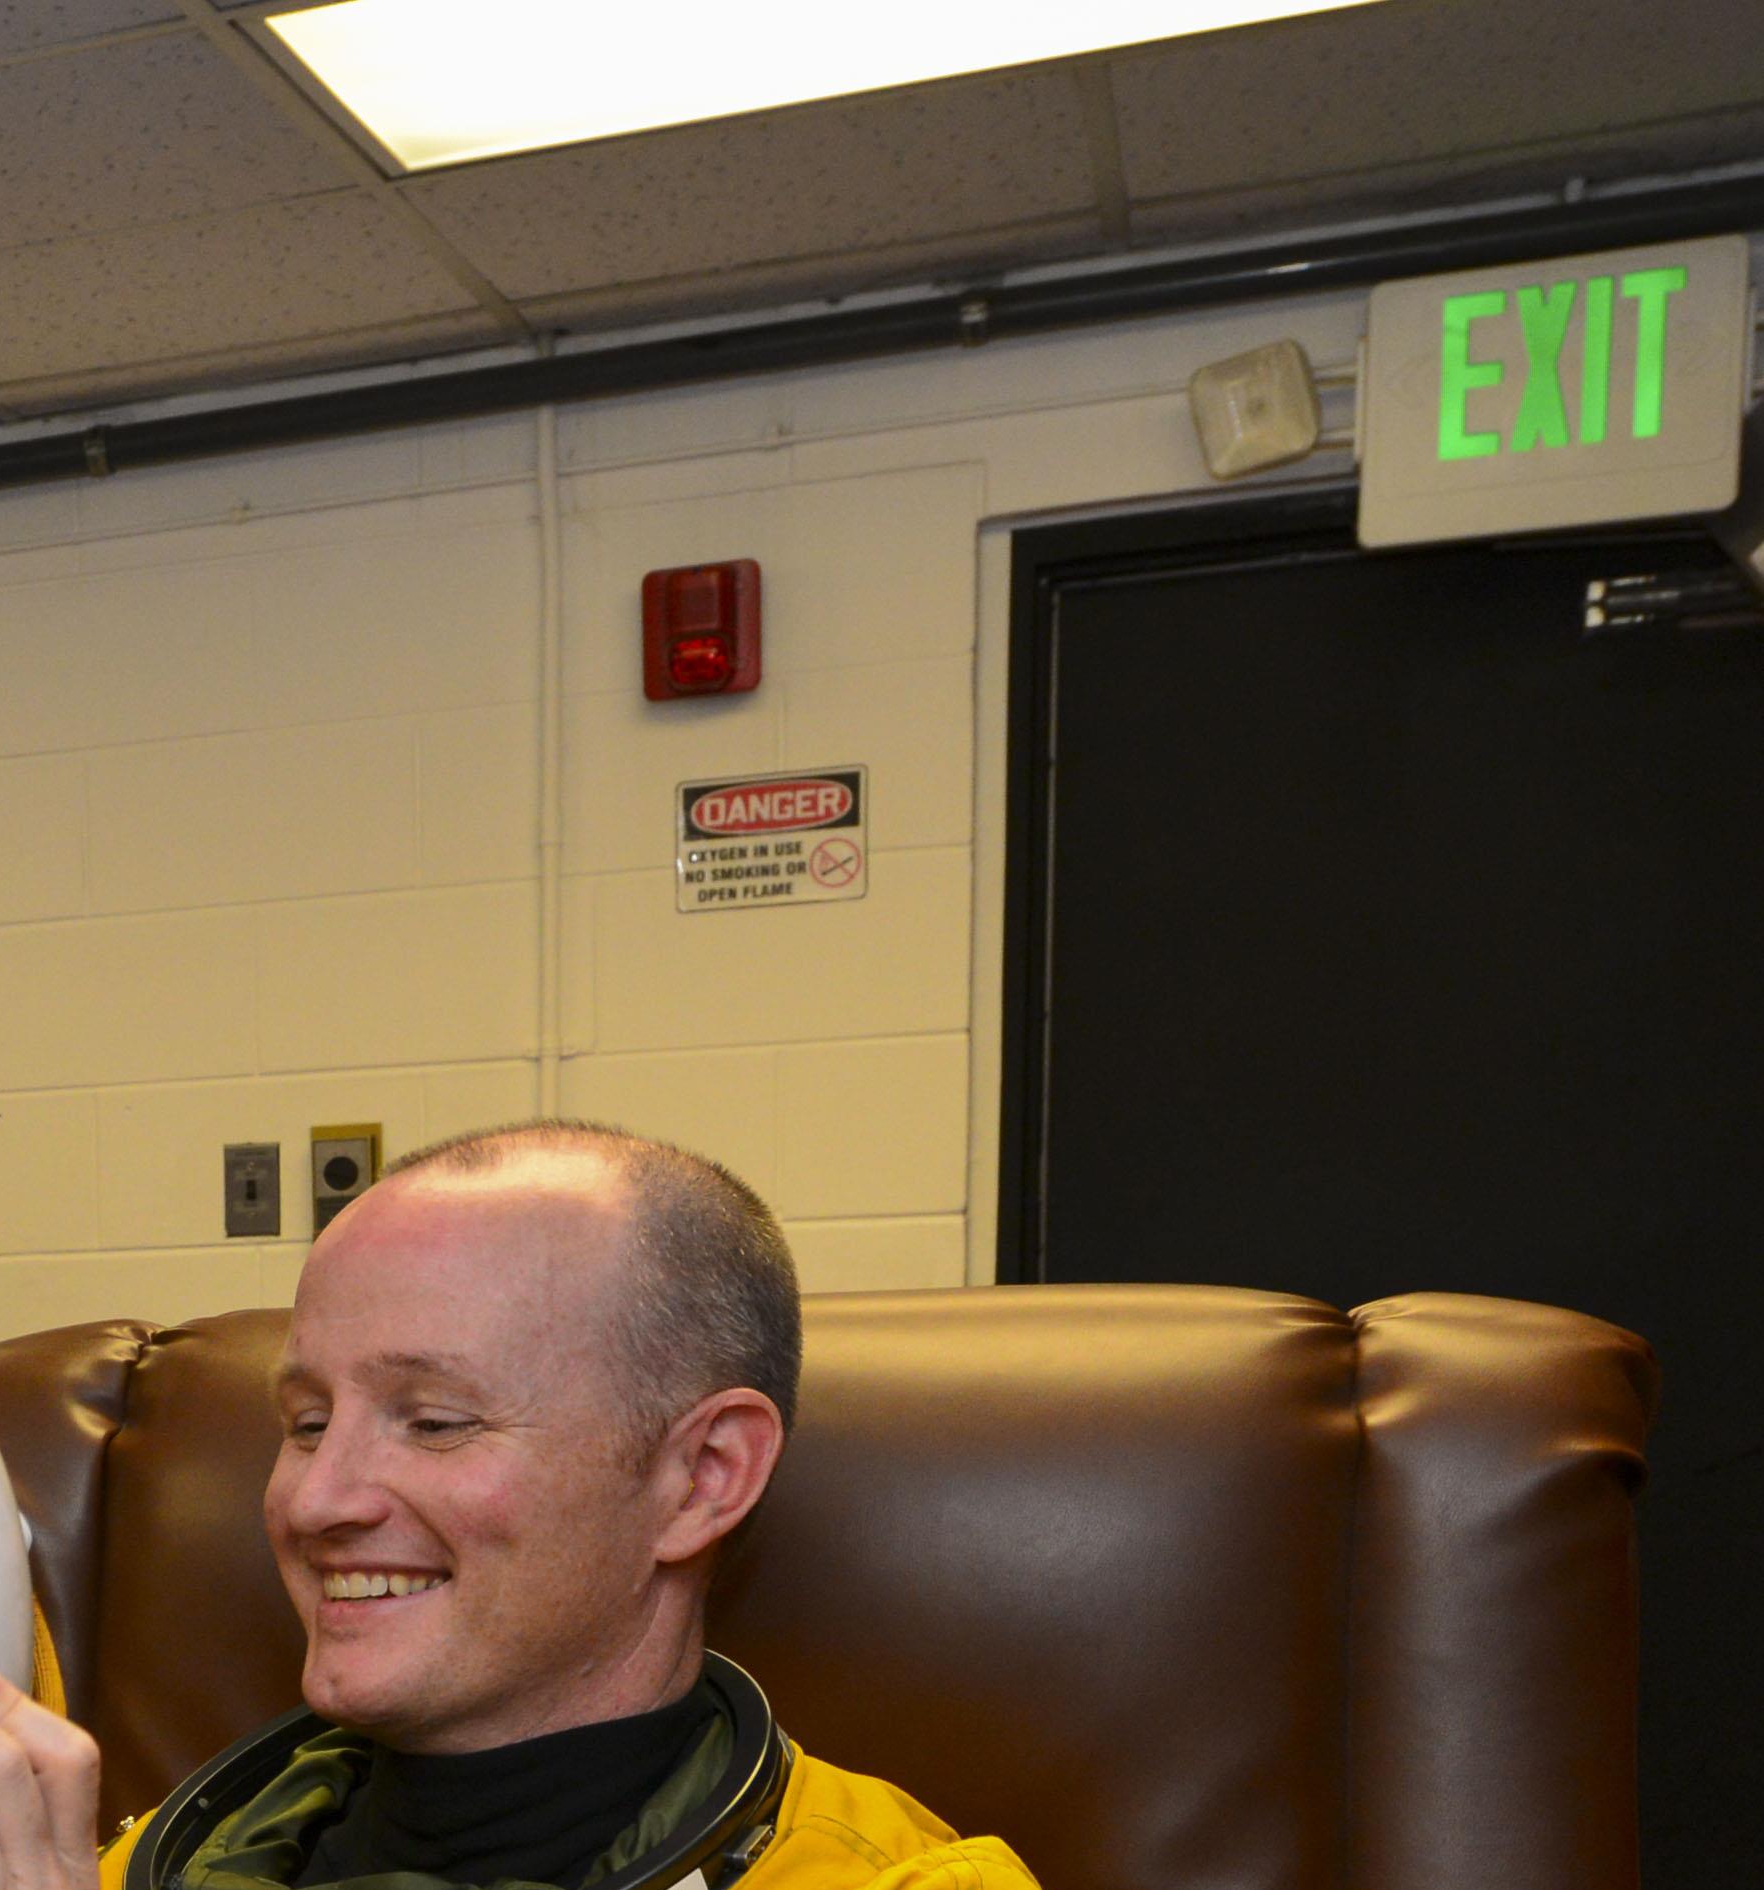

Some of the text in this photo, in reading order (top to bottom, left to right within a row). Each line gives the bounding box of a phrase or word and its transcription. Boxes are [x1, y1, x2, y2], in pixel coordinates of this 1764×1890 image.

[1438, 266, 1687, 460] EXIT
[702, 786, 842, 827] DANGER
[688, 841, 802, 864] OXYGEN IN USE
[685, 861, 806, 883] NO SMOKING OR
[697, 882, 793, 903] OPEN FLAME
